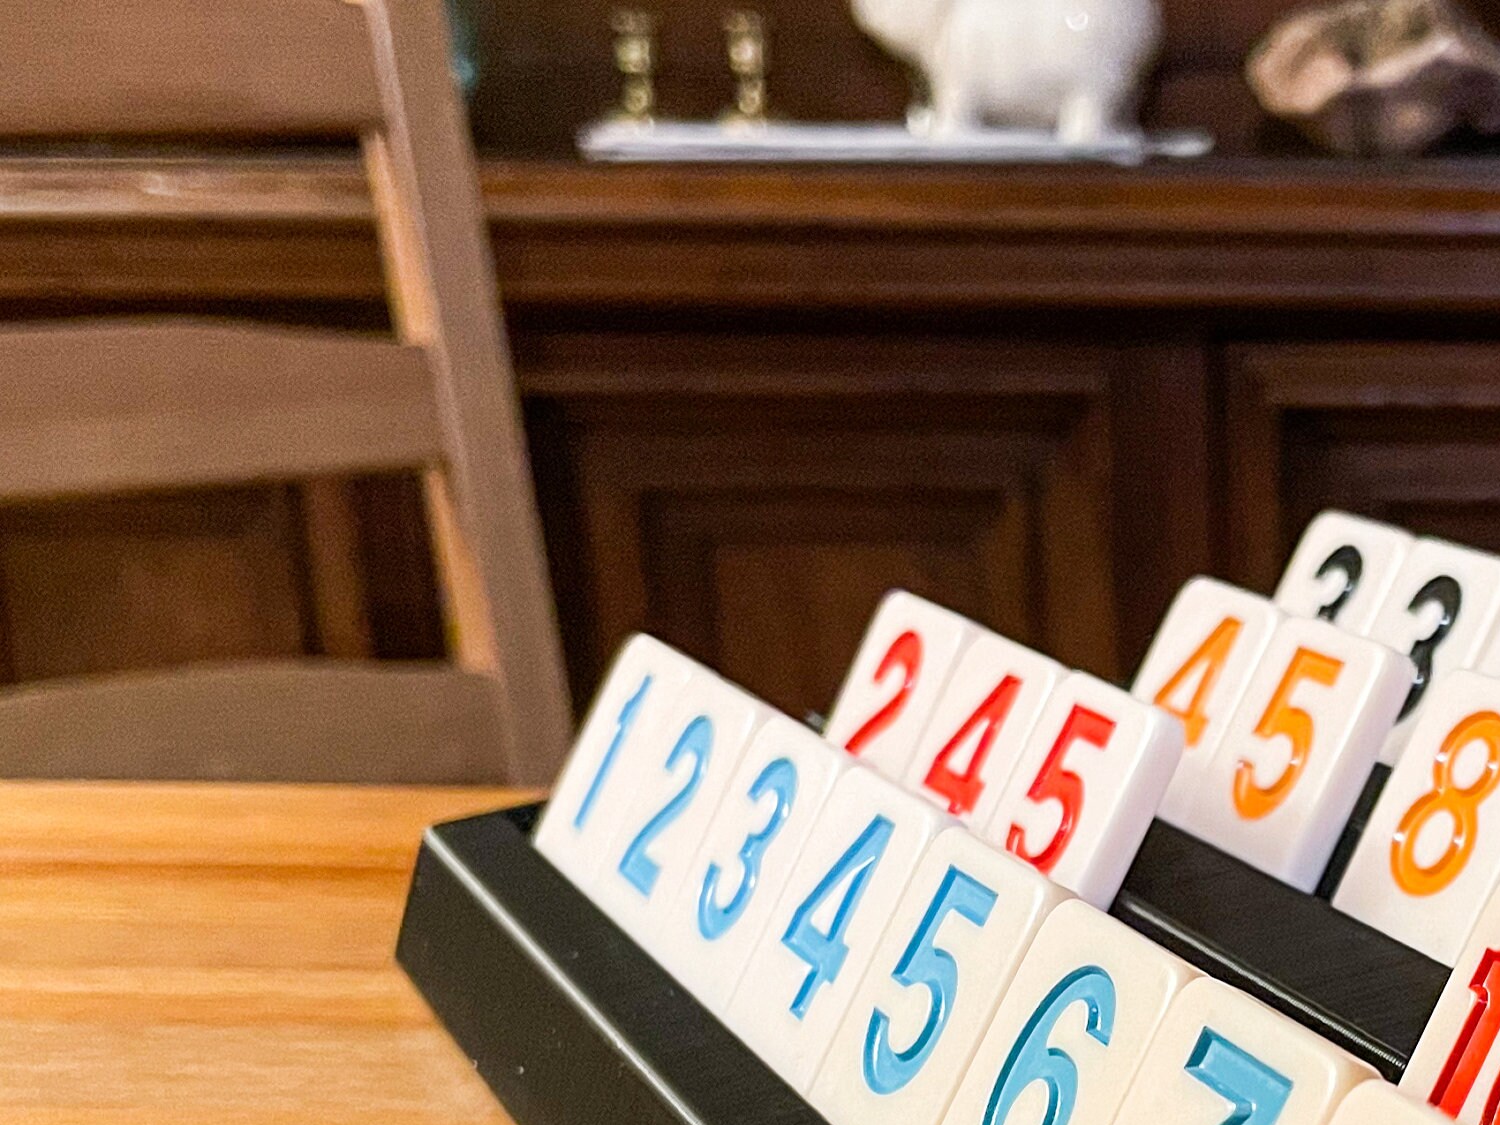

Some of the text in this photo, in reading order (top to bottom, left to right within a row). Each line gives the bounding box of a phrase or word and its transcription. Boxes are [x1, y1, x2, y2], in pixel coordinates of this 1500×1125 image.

[845, 630, 924, 756] 2
[1153, 616, 1244, 747] 4
[1232, 646, 1345, 821] 5
[1395, 575, 1463, 726] 3
[574, 675, 652, 829] 1
[617, 715, 714, 896] 2
[923, 674, 1023, 815] 4
[1006, 703, 1117, 876] 5
[699, 758, 798, 941] 3
[781, 814, 895, 1021] 4
[863, 864, 999, 1095] 5
